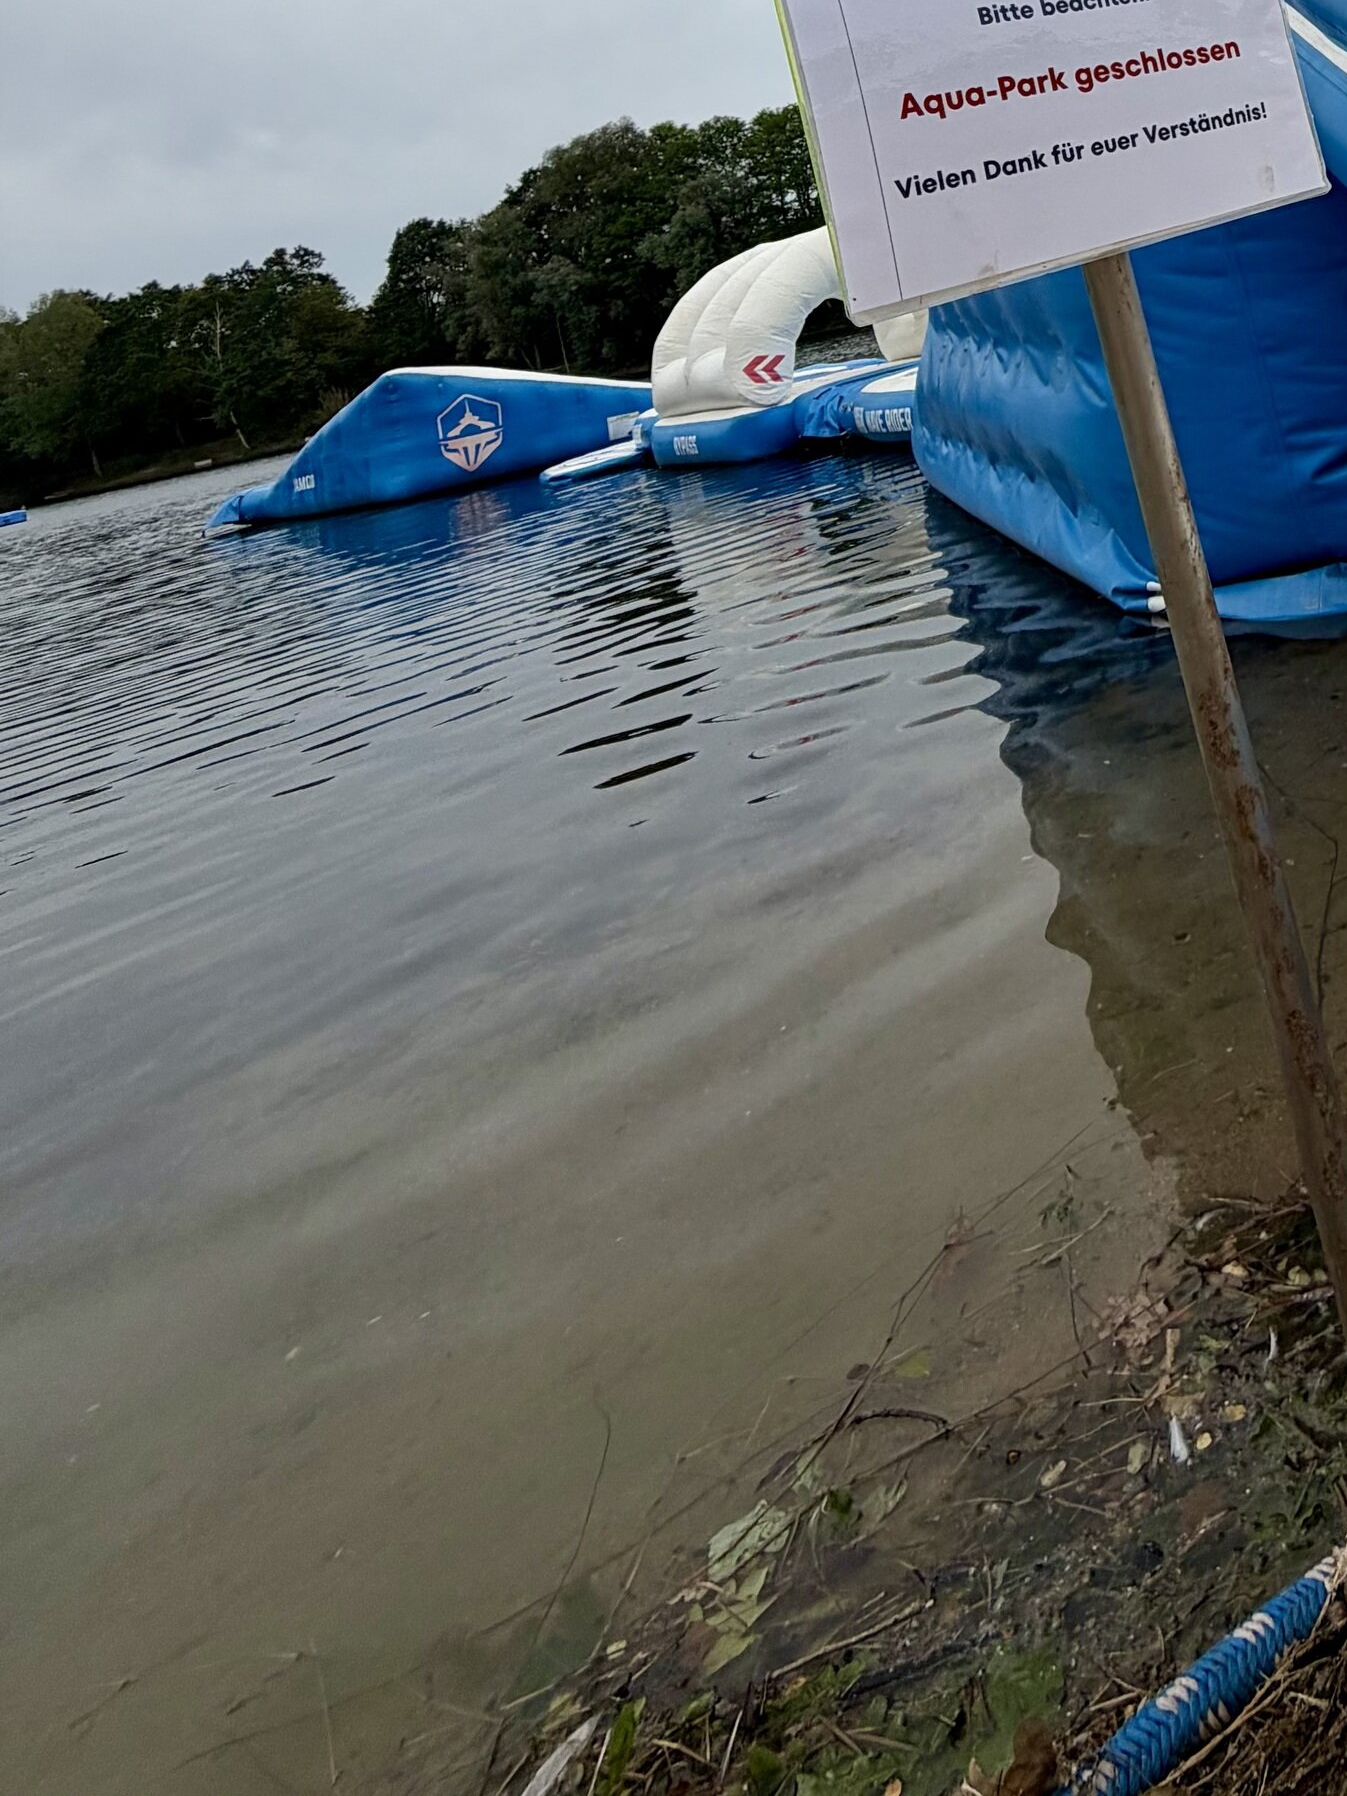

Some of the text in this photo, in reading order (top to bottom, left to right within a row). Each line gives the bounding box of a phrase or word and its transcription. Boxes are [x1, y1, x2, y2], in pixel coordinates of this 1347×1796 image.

[976, 3, 1035, 26] Bitte
[900, 41, 1241, 120] Aqua-Park geschlossen
[893, 101, 1268, 199] Vielen Dank für euer Verständnis!
[884, 407, 912, 432] RIDER
